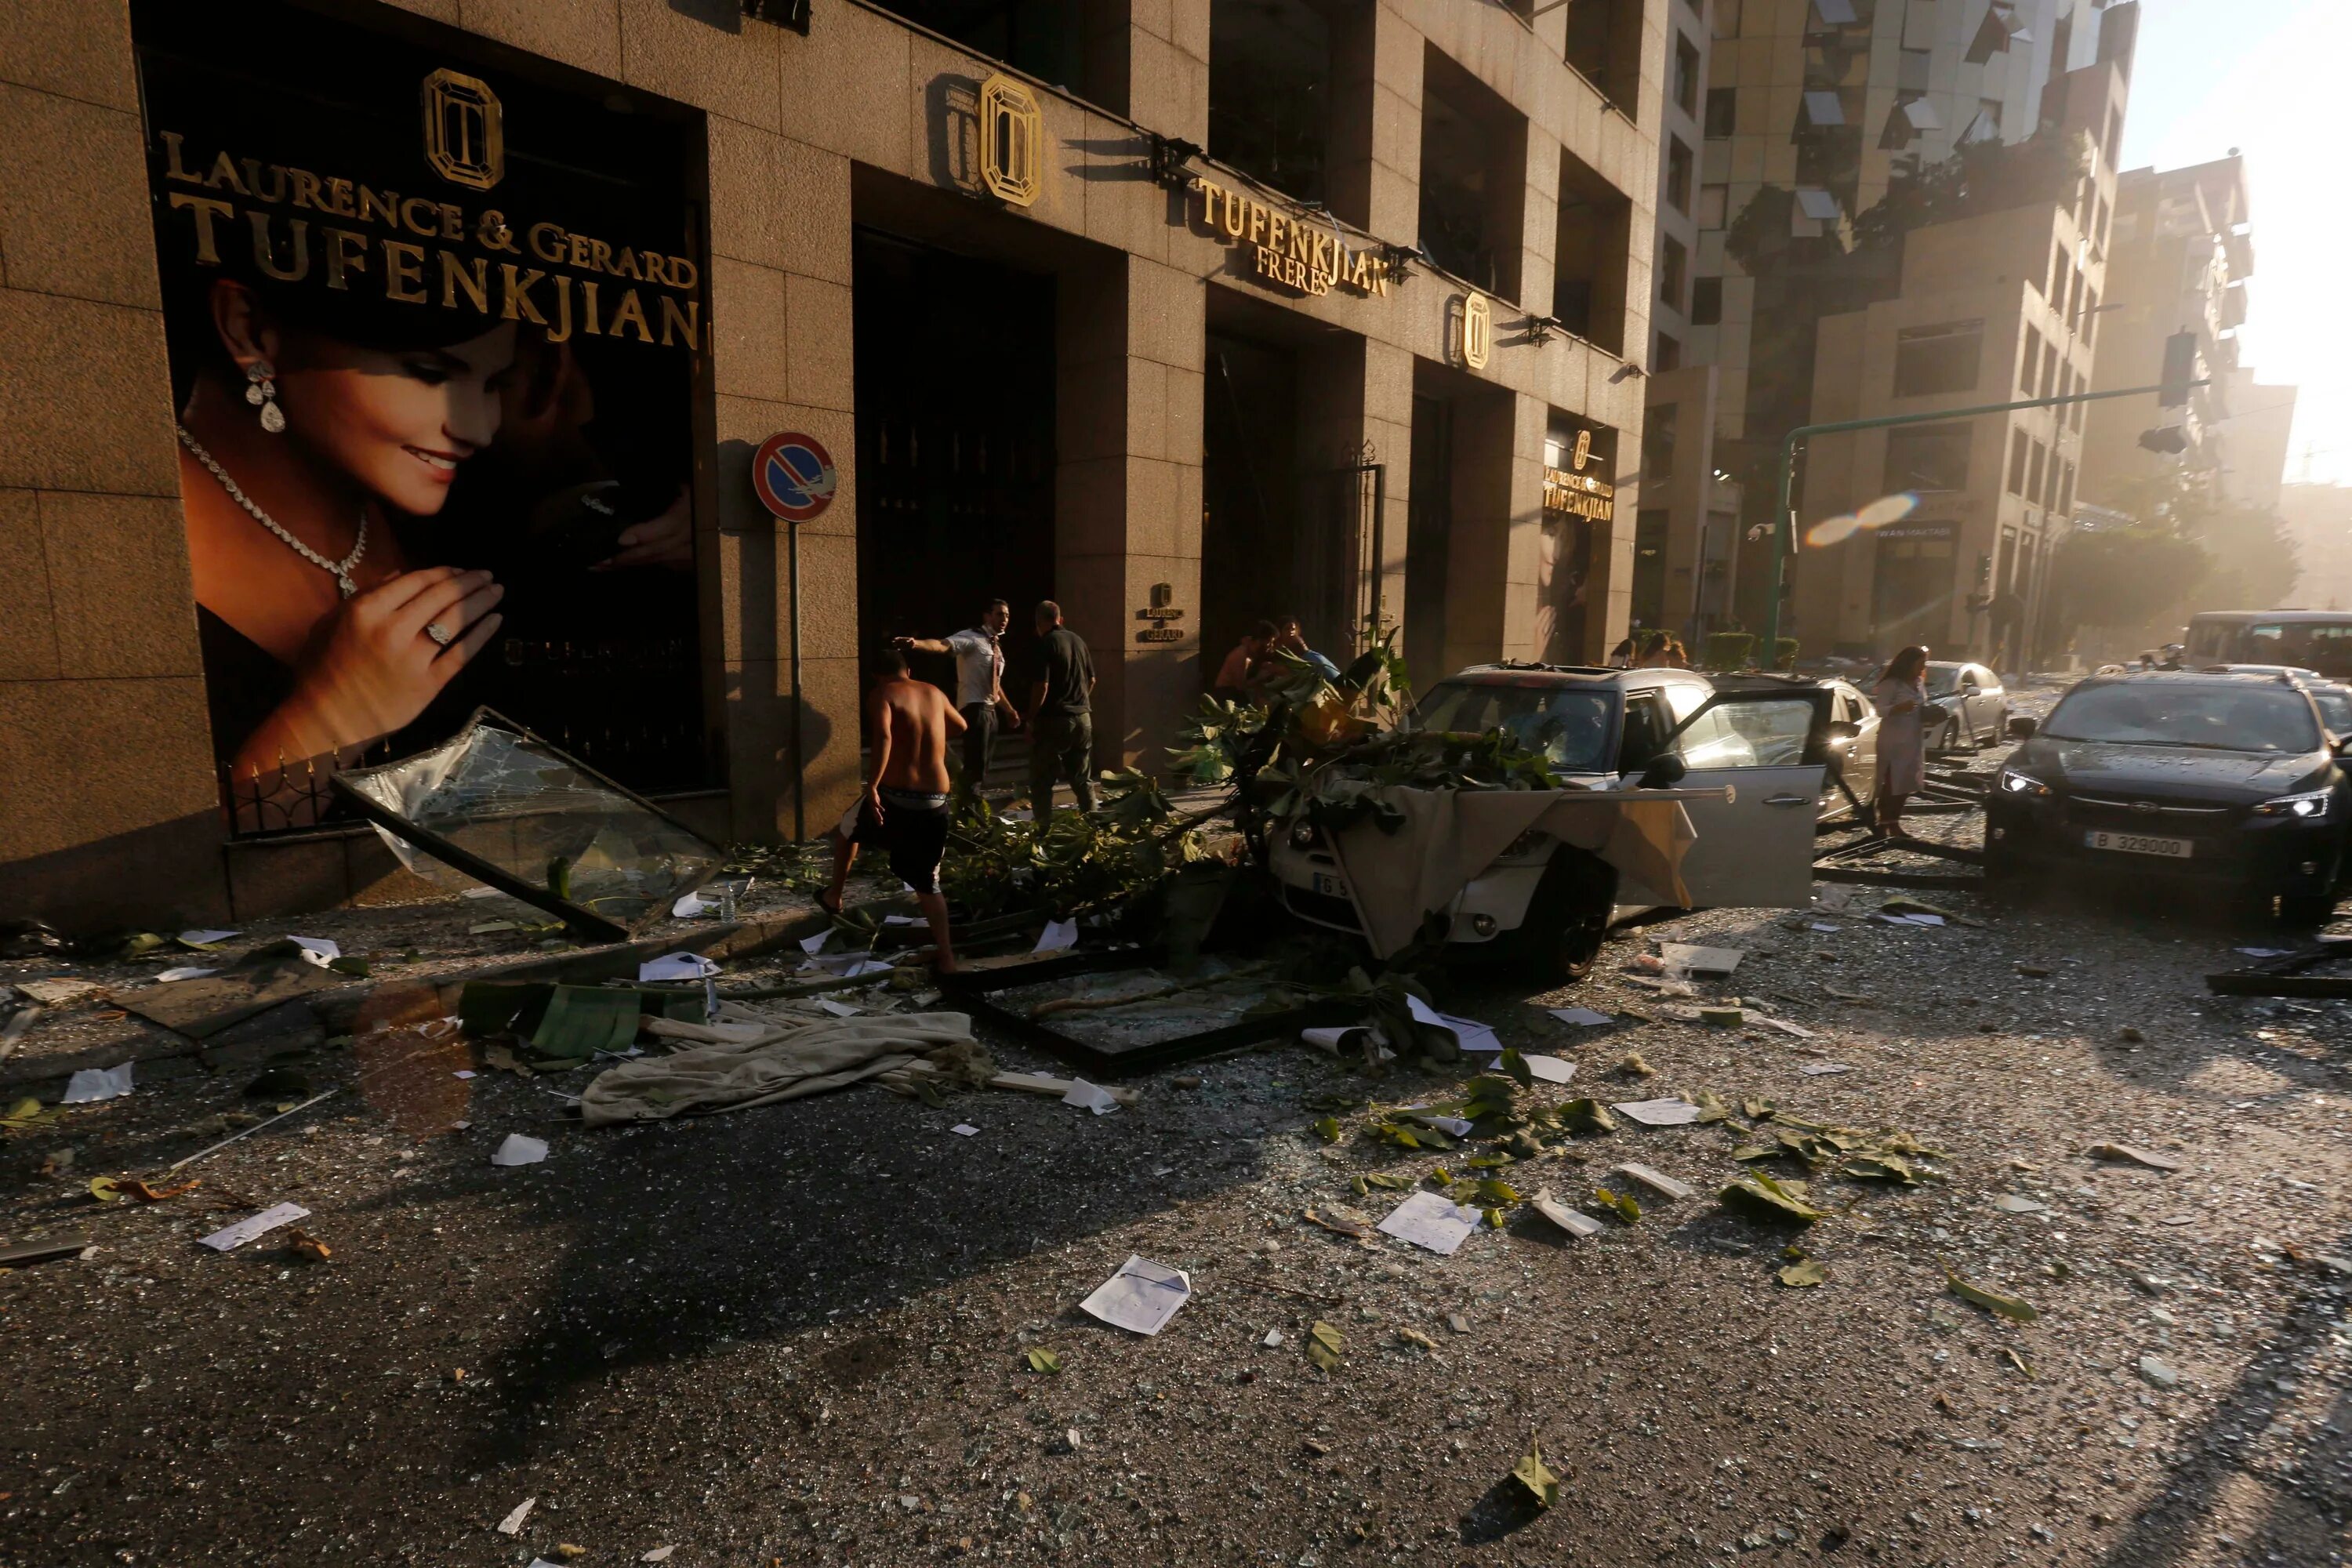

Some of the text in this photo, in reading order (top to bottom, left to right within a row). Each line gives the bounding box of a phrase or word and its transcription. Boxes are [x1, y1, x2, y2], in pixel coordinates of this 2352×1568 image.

[160, 129, 699, 289] LAURENCE & GERARD
[1198, 177, 1388, 298] TUFENKJIAN
[169, 191, 699, 351] TUFENKJIAN
[1256, 245, 1329, 297] FRERES
[1543, 485, 1613, 523] TUFENKJIAN
[2098, 834, 2181, 855] B 329000
[1324, 879, 1331, 893] G
